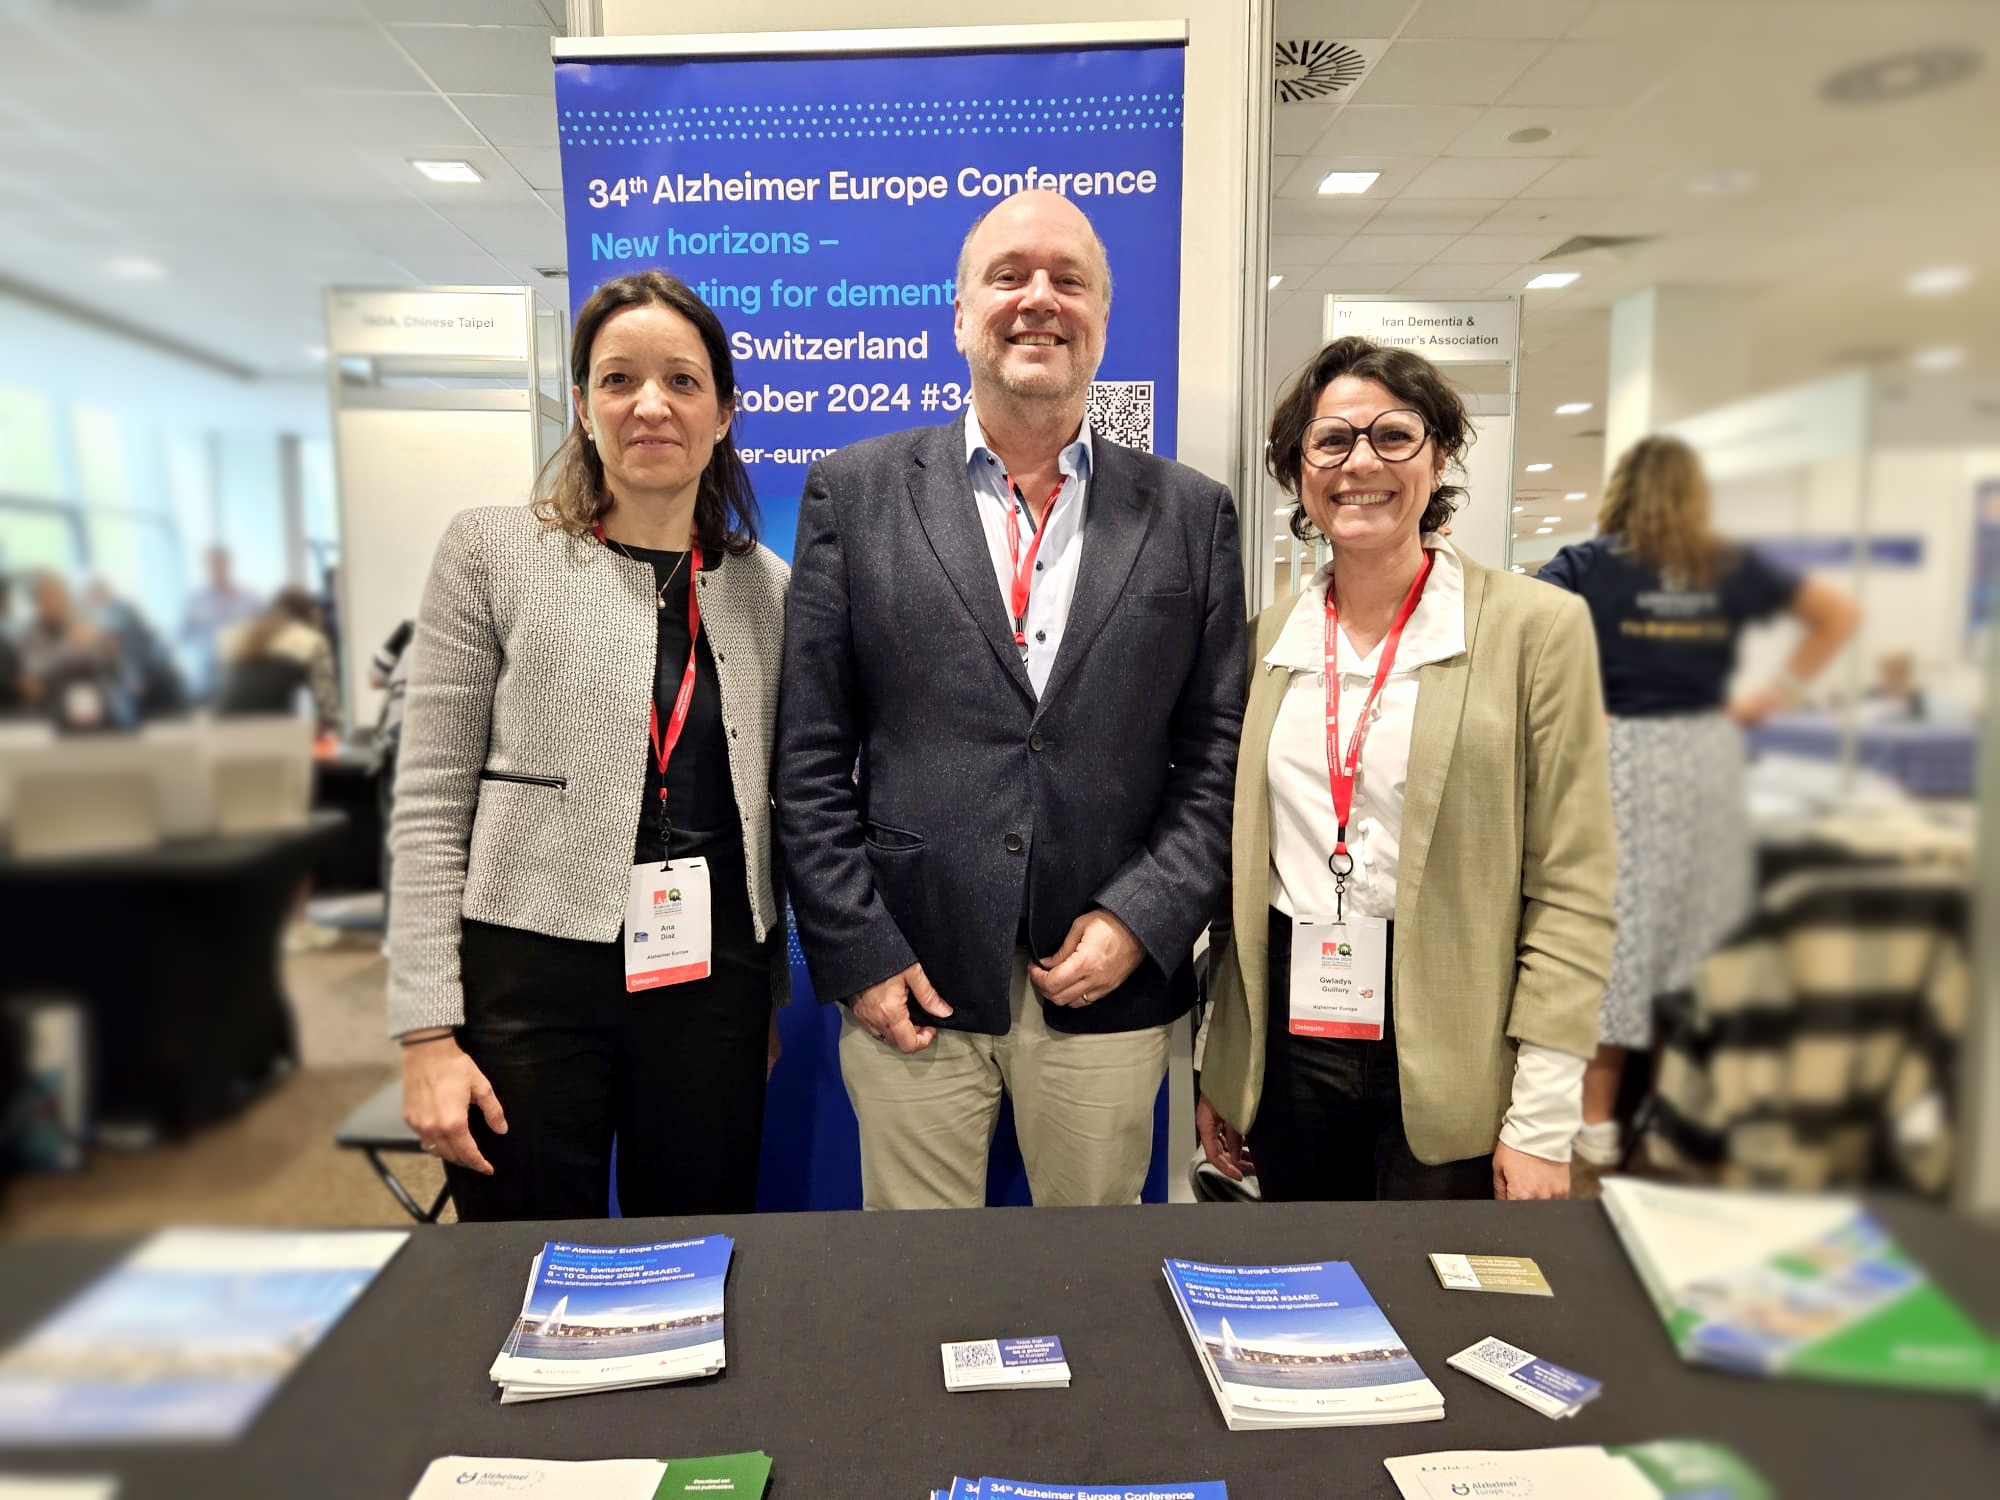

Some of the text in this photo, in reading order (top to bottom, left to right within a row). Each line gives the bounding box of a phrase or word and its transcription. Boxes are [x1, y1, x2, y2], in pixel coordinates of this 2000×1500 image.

[588, 166, 1157, 209] 34th Alzheimer Europe Conference
[591, 232, 659, 261] New
[668, 224, 810, 256] horizons
[770, 278, 818, 308] for
[826, 279, 955, 307] dement
[403, 316, 454, 328] Chinese
[457, 317, 494, 330] Taipei
[1382, 316, 1475, 327] Iran Dementia &
[731, 331, 928, 360] Switzerland
[1429, 335, 1499, 345] Association
[734, 384, 818, 412] tober
[827, 383, 911, 412] 2024
[1320, 977, 1352, 985] Gwladys
[1322, 986, 1349, 994] Guillory
[619, 1246, 651, 1254] Europe
[654, 1240, 705, 1251] Conference
[549, 1264, 644, 1273] Geneva, Switzerland
[616, 1272, 640, 1280] 2024
[642, 1267, 681, 1277] #34AEC
[1193, 1265, 1236, 1274] Alzheimer
[1271, 1265, 1323, 1274] Conference
[1225, 1287, 1278, 1295] Switzerland
[1217, 1293, 1253, 1302] October
[1280, 1293, 1320, 1302] #34AEC
[480, 1472, 529, 1480] Alzheimer
[1472, 1481, 1518, 1489] Alzheimer
[1014, 1487, 1075, 1500] Alzheimer
[1077, 1491, 1122, 1500] Europe
[1124, 1491, 1195, 1500] Conference
